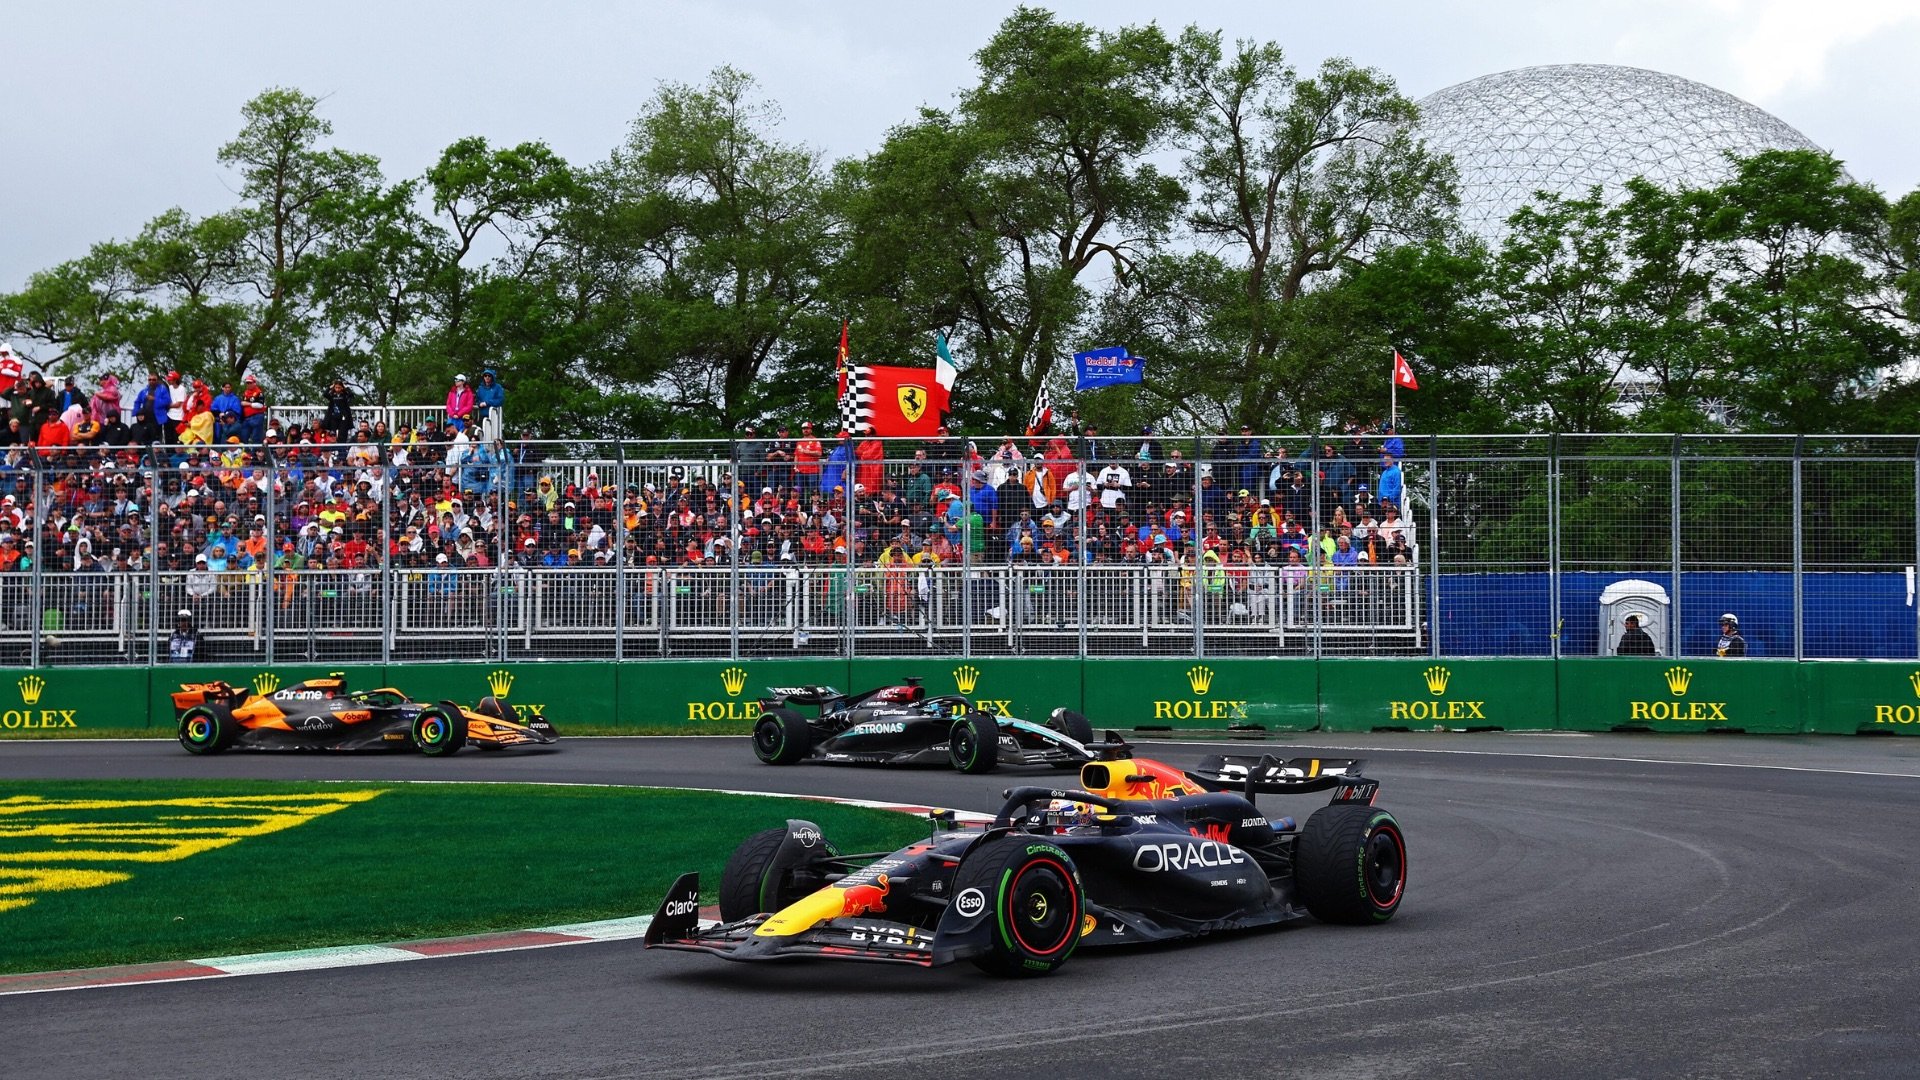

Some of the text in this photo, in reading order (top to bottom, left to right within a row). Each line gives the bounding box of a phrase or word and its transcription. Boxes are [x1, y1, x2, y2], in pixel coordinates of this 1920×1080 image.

[273, 689, 323, 700] Chrome
[687, 702, 760, 720] ROLE
[1154, 701, 1248, 719] ROLEX
[1390, 701, 1486, 719] ROLEX
[1630, 701, 1728, 720] ROLEX
[1874, 705, 1920, 724] RO
[0, 710, 78, 728] OLEX
[297, 721, 333, 731] workday
[854, 723, 904, 735] PETRONAS
[998, 736, 1014, 745] IWC
[1334, 784, 1366, 800] Mobil
[1241, 817, 1268, 828] HONDA
[807, 831, 821, 840] Rock
[1026, 844, 1069, 862] Cinturato
[1133, 841, 1244, 872] ORACLE
[666, 900, 694, 916] Claro
[961, 897, 981, 908] Esso
